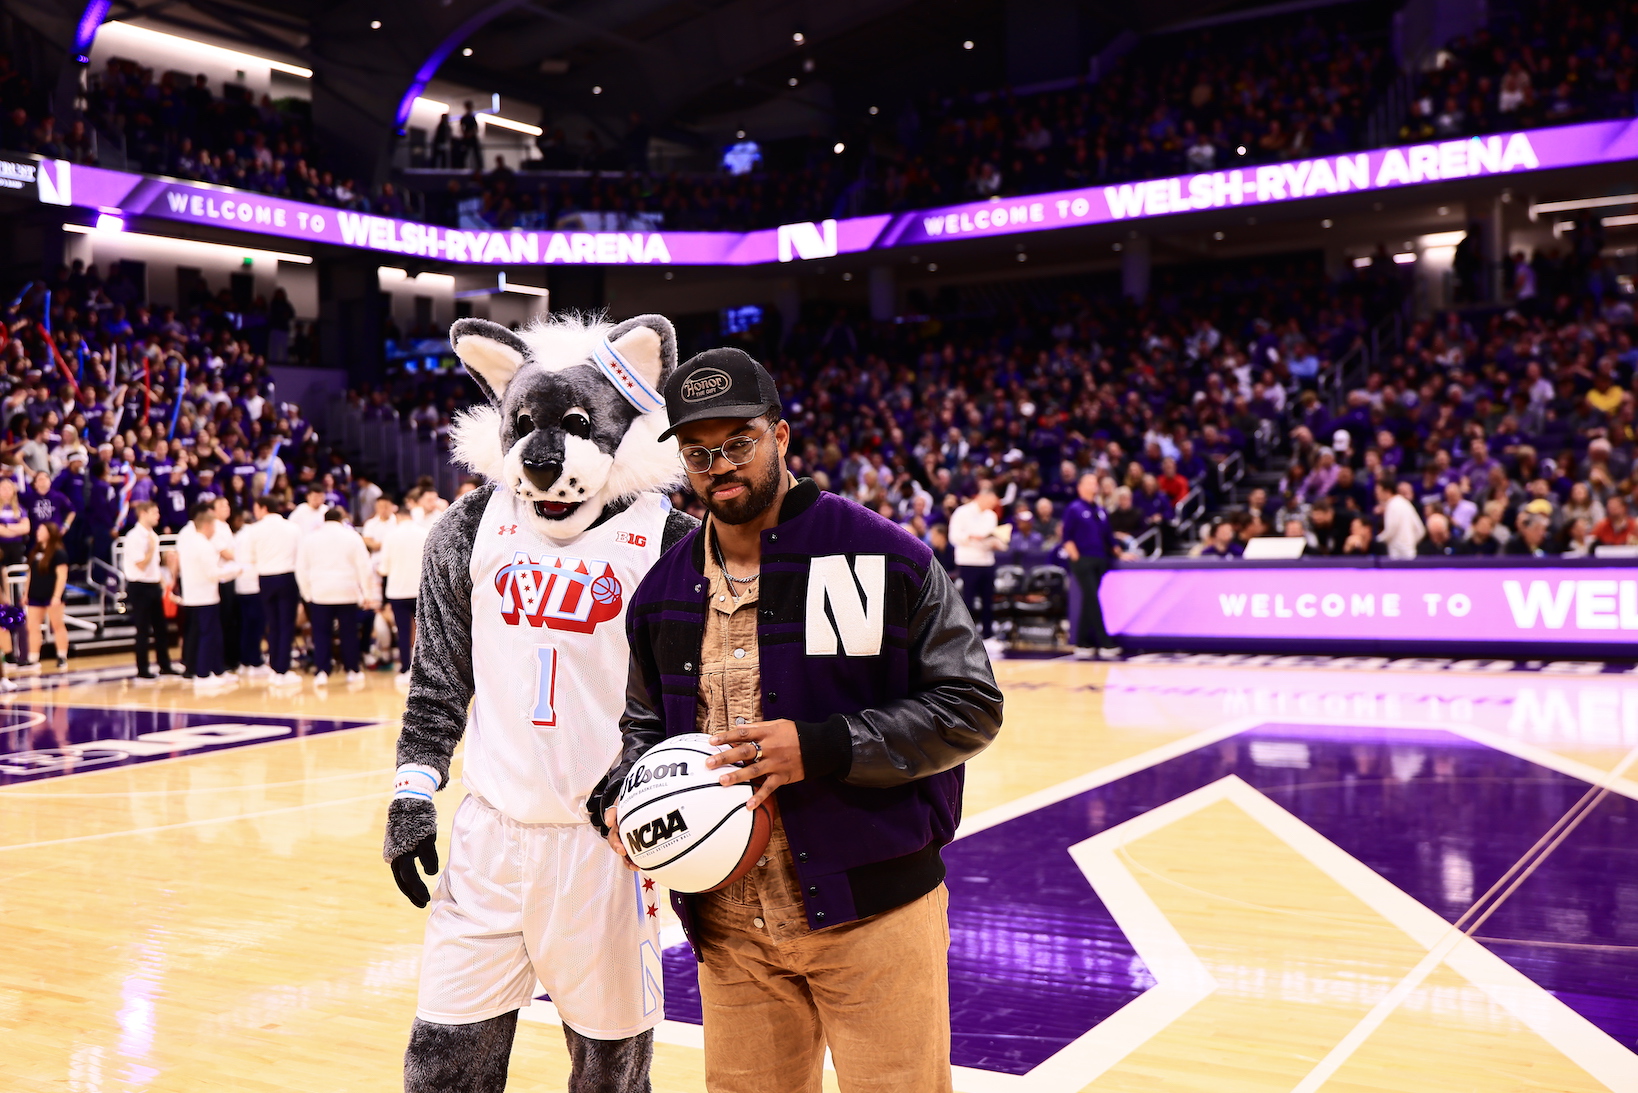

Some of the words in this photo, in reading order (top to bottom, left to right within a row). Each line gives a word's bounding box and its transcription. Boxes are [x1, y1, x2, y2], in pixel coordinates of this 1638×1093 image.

[923, 203, 1044, 236] WELCOME
[1055, 197, 1090, 219] TO
[1103, 153, 1370, 220] WELSH-RYAN
[1376, 132, 1539, 187] ARENA
[167, 191, 286, 227] WELCOME
[296, 211, 326, 233] TO
[336, 211, 538, 262] WELSH-RYAN
[543, 232, 672, 263] ARENA
[777, 219, 837, 262] N
[501, 551, 610, 634] NU
[806, 554, 886, 656] N
[1218, 593, 1401, 618] WELCOME
[1422, 593, 1472, 617] TO
[531, 645, 557, 727] 1
[626, 809, 688, 855] NCAA
